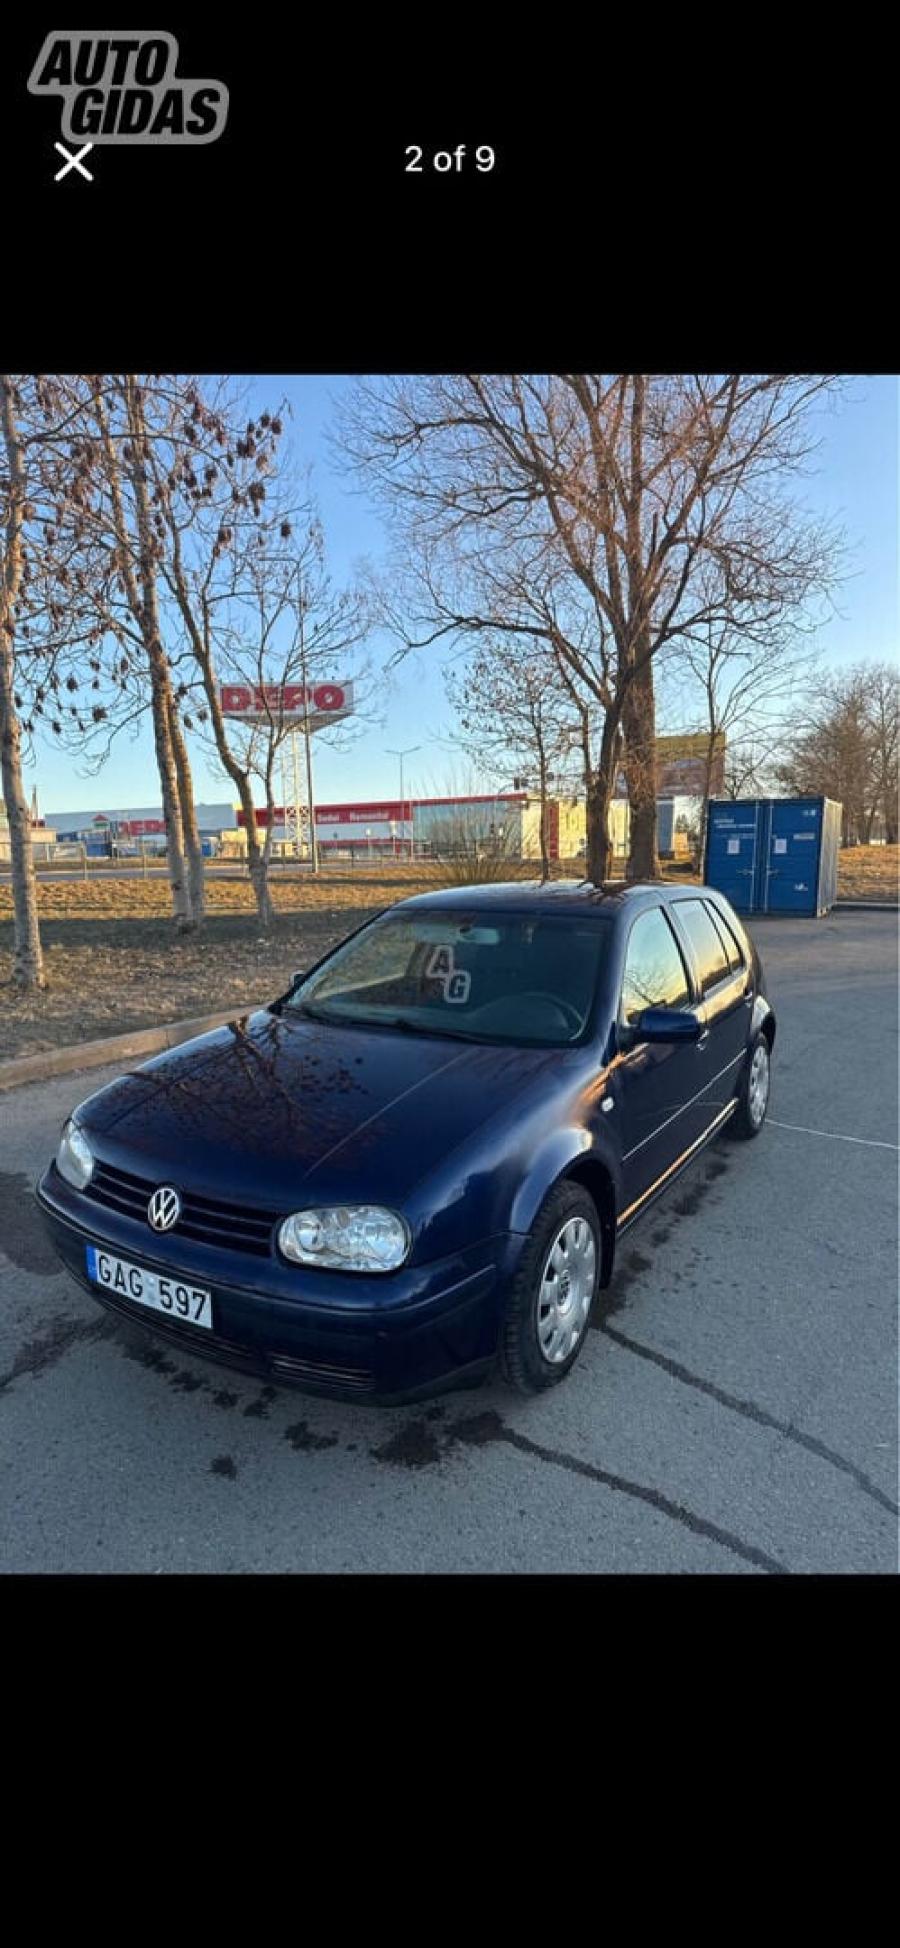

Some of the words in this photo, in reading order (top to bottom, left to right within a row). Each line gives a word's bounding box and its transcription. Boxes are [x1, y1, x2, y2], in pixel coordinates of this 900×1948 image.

[222, 684, 345, 711] DEPO
[148, 1187, 180, 1232] VW
[98, 1254, 144, 1298] GAG
[157, 1280, 207, 1321] 597
